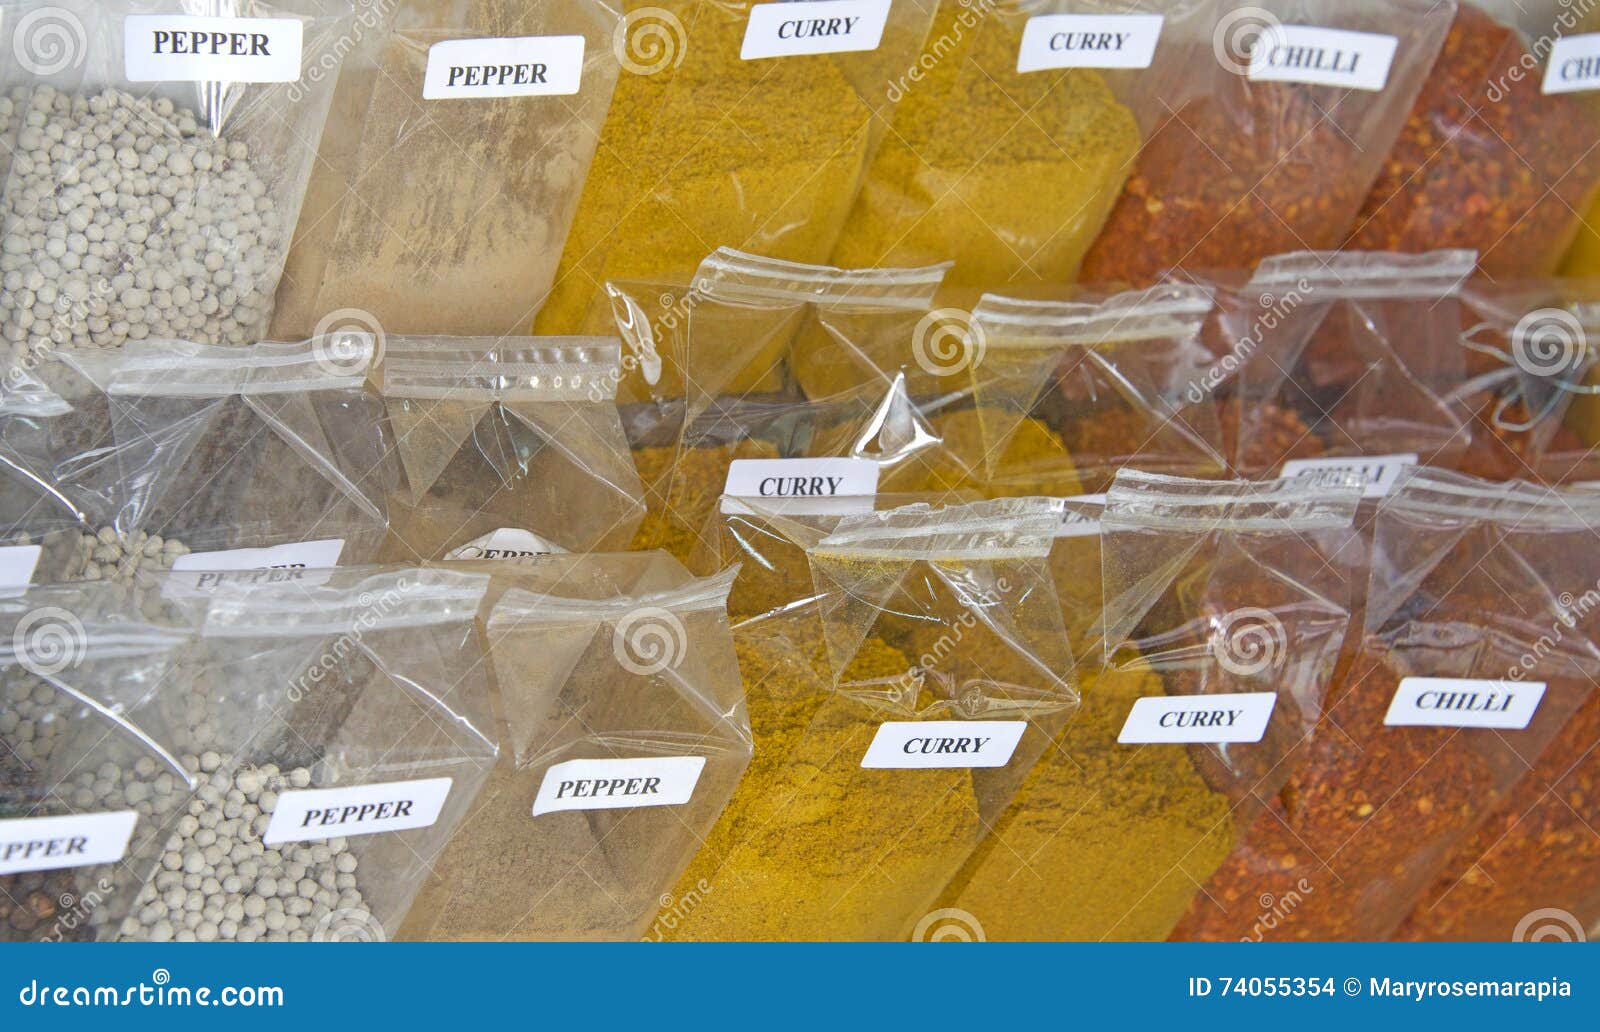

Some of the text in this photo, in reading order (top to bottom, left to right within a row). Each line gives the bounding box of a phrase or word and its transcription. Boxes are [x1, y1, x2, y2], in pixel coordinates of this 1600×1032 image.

[777, 17, 861, 40] CURRY
[152, 30, 271, 56] PEPPER
[1049, 32, 1131, 52] CURRY
[1268, 46, 1360, 74] CHILLI
[446, 63, 548, 87] PEPPER
[759, 476, 844, 498] CURRY
[1415, 691, 1515, 713] CHILLI
[1159, 709, 1243, 728] CURRY
[903, 737, 990, 755] CURRY
[555, 776, 661, 800] PEPPER
[301, 800, 414, 828] PEPPER
